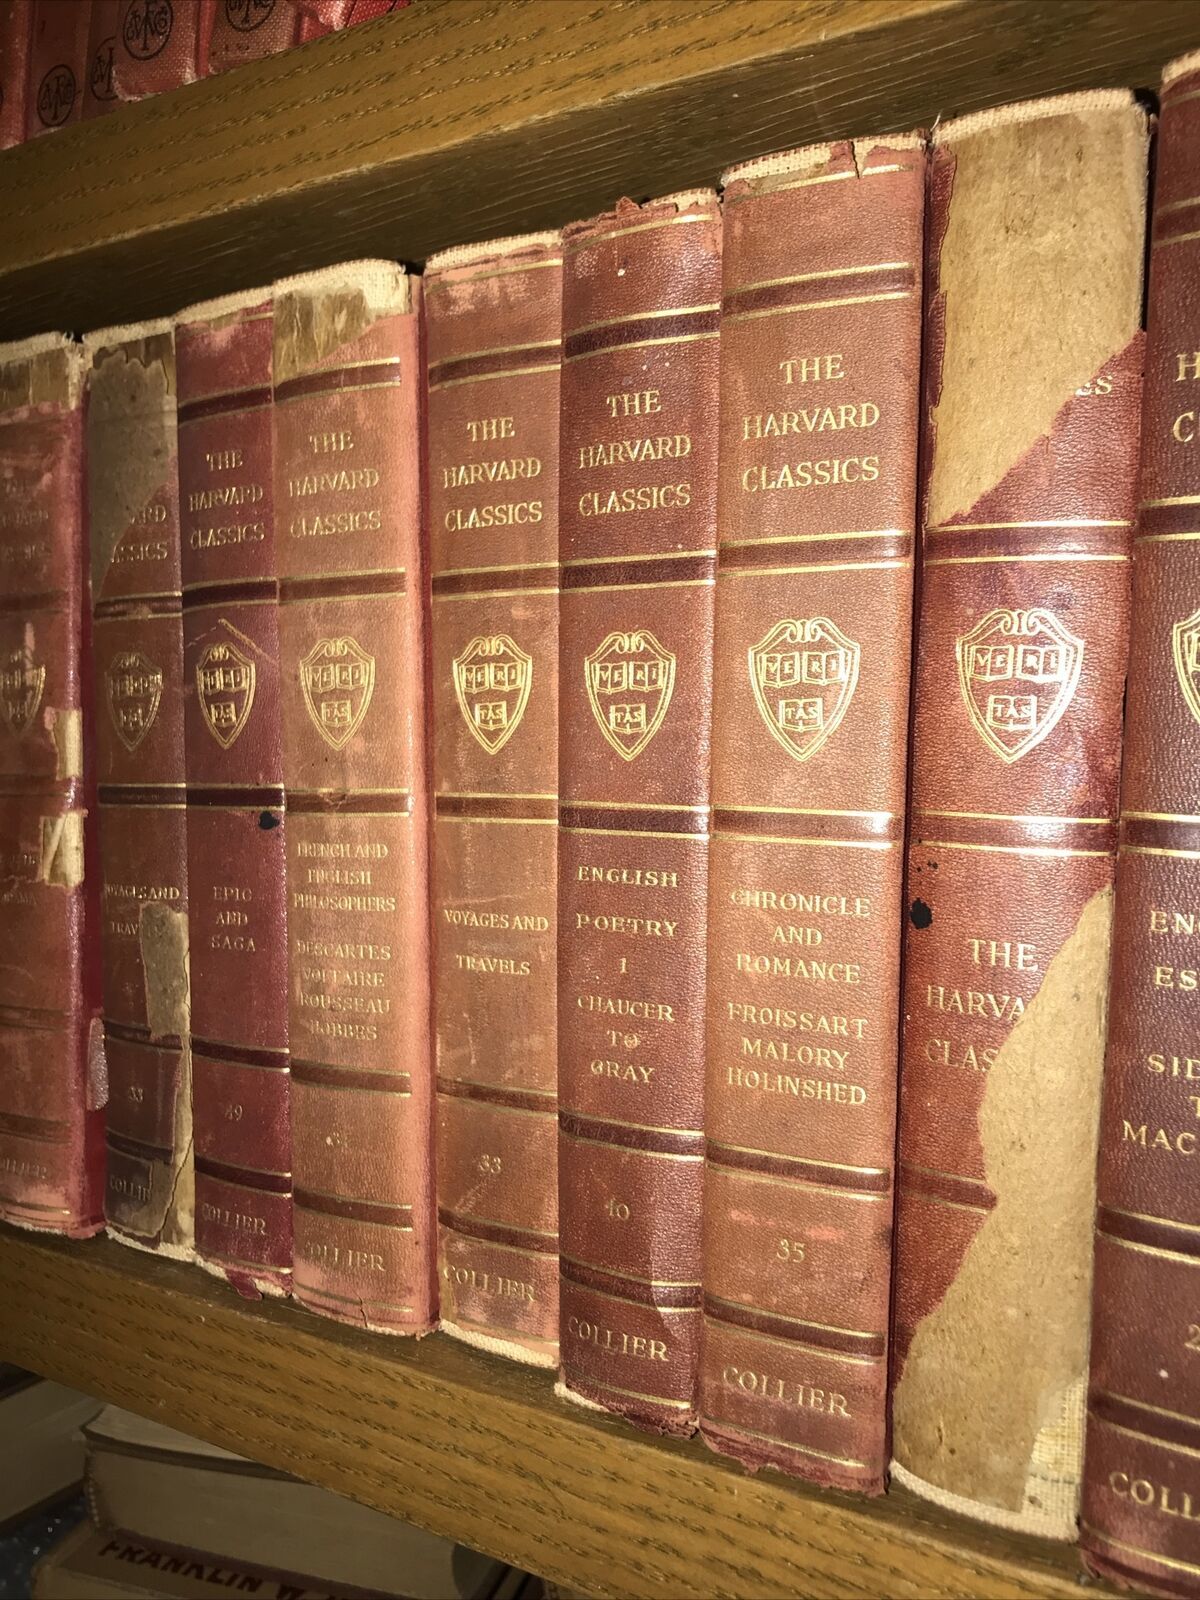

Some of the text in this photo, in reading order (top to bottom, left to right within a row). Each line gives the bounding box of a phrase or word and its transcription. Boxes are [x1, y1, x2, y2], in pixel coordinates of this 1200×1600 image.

[780, 355, 845, 385] THE
[607, 390, 662, 417] THE
[467, 417, 515, 442] THE
[742, 402, 880, 441] HARVARD
[310, 432, 354, 453] THE
[578, 435, 692, 469] HARVARD
[206, 451, 243, 471] THE
[443, 458, 542, 489] HARVARD
[289, 468, 380, 497] HARVARD
[742, 456, 880, 493] CLASSICS
[189, 486, 263, 512] HARVARD
[579, 484, 691, 517] CLASSICS
[290, 511, 381, 538] CLASSICS
[445, 501, 543, 532] CLASSICS
[190, 523, 265, 550] CLASSICS
[355, 844, 389, 858] AND
[308, 869, 372, 885] ENGLISH
[577, 866, 678, 888] ENGLISH
[149, 886, 180, 900] AND
[213, 886, 253, 901] EPIC
[293, 893, 396, 912] PHILOSOPHERS
[731, 889, 871, 917] CHRONICLE
[215, 911, 248, 926] AND
[444, 910, 549, 931] VOYAGES AND
[576, 913, 679, 937] POETRY
[211, 935, 256, 952] SAGA
[773, 926, 823, 946] AND
[297, 940, 391, 961] DESCARTES
[968, 938, 1038, 972] THE
[302, 968, 385, 987] VOLTAIRE
[456, 955, 531, 976] TRAVELS
[737, 953, 860, 984] ROMANCE
[300, 991, 390, 1014] ROUSSEAU
[577, 995, 675, 1022] CHAUCER
[310, 1019, 378, 1041] HOBBES
[728, 1002, 868, 1039] FROISSART
[607, 1030, 641, 1049] TO
[742, 1037, 849, 1070] MALORY
[591, 1060, 655, 1083] GRAY
[728, 1067, 867, 1105] HOLINSHED
[479, 1154, 501, 1174] 33
[201, 1202, 267, 1235] COLLIER
[776, 1238, 805, 1263] 35
[443, 1264, 535, 1301] COLLIER
[568, 1317, 669, 1362] COLLIER
[723, 1367, 851, 1417] COLLIER
[98, 1541, 264, 1593] FRANKLIN
